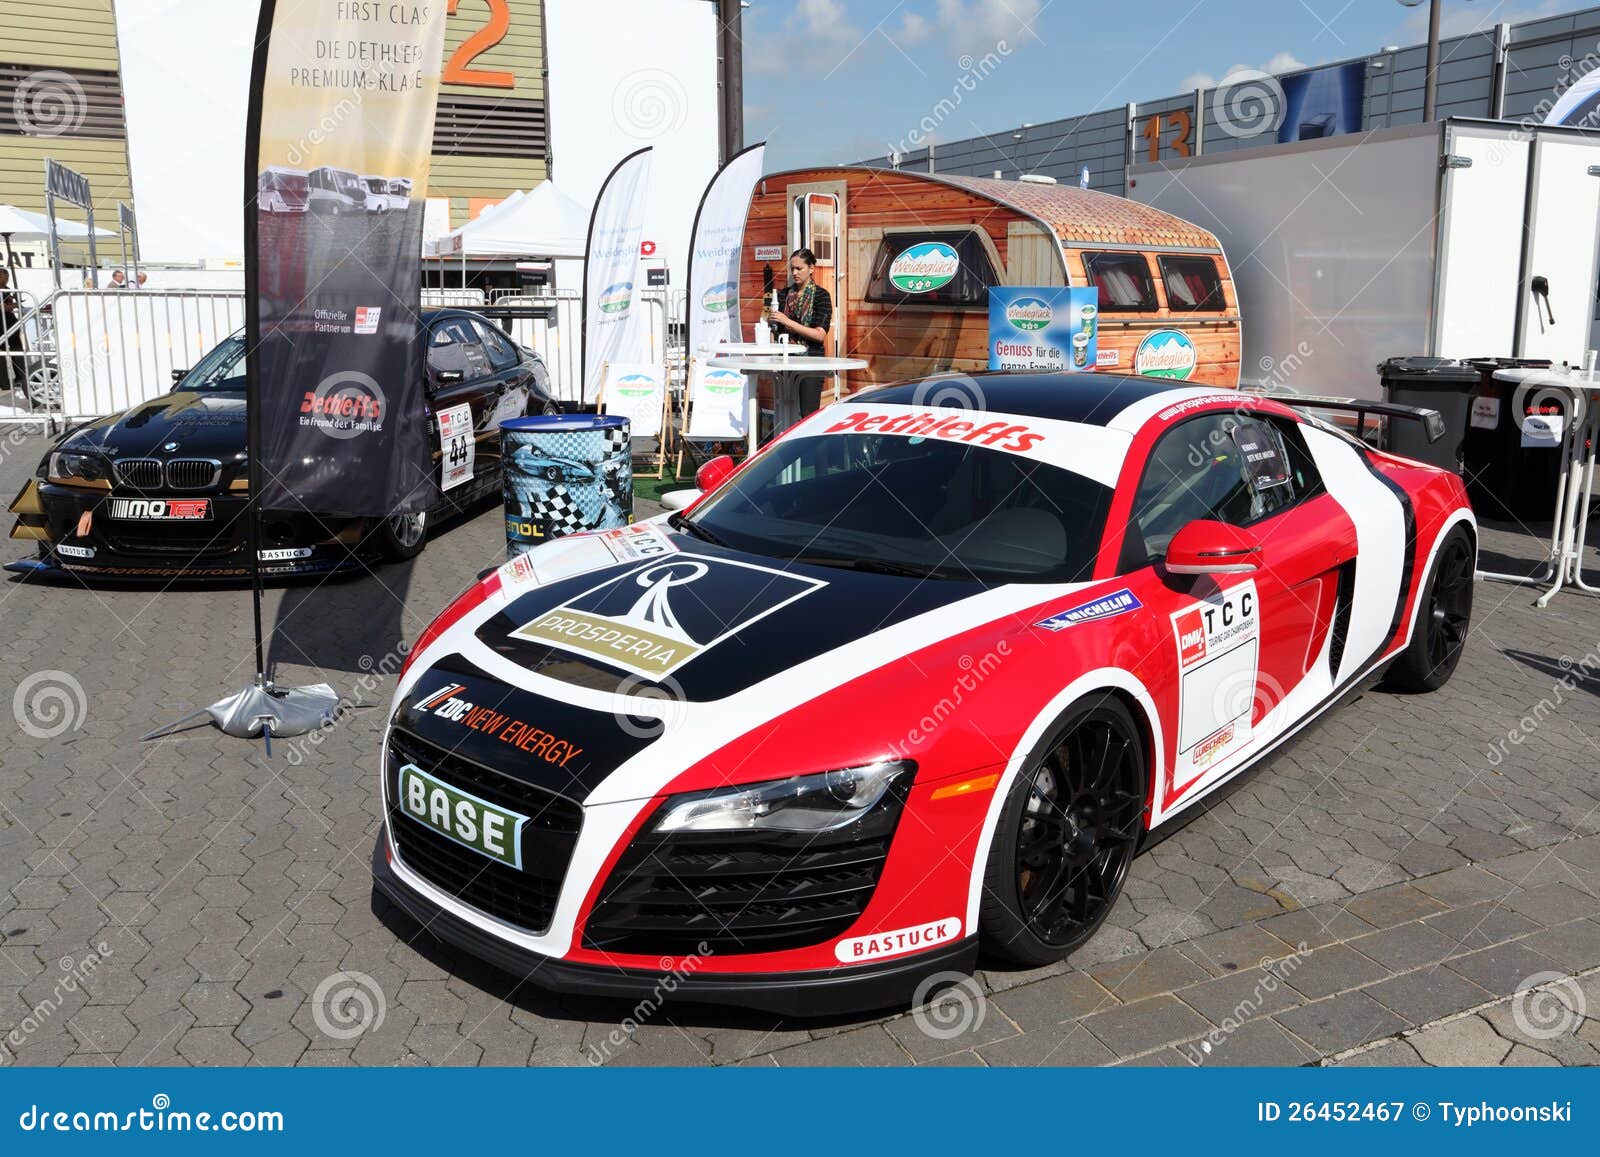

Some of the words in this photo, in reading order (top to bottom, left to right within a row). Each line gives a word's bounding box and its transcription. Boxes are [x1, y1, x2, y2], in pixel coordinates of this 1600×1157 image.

[338, 1, 380, 22] FIRST
[316, 40, 340, 59] DIE
[441, 0, 515, 89] 2
[1143, 111, 1191, 162] 13
[893, 259, 955, 277] Weideglück
[314, 308, 348, 321] Offizieller
[1008, 308, 1051, 321] Weideglück
[314, 321, 340, 333] Partner
[996, 340, 1033, 356] Genuss
[1036, 346, 1047, 357] für
[1049, 346, 1060, 358] die
[1139, 350, 1192, 369] Weideglück
[300, 416, 310, 426] Ein
[310, 417, 334, 428] Freund
[334, 418, 349, 429] der
[351, 420, 382, 432] Familie
[823, 412, 1045, 452] Dethleffs
[450, 435, 468, 466] 44
[260, 549, 306, 560] BASTUCK
[1065, 594, 1133, 621] MICHELIN
[536, 615, 677, 665] PROSPERIA
[461, 705, 510, 735] NEW
[499, 720, 583, 767] ENERGY
[408, 774, 505, 856] BASE
[853, 924, 948, 957] BASTUCK
